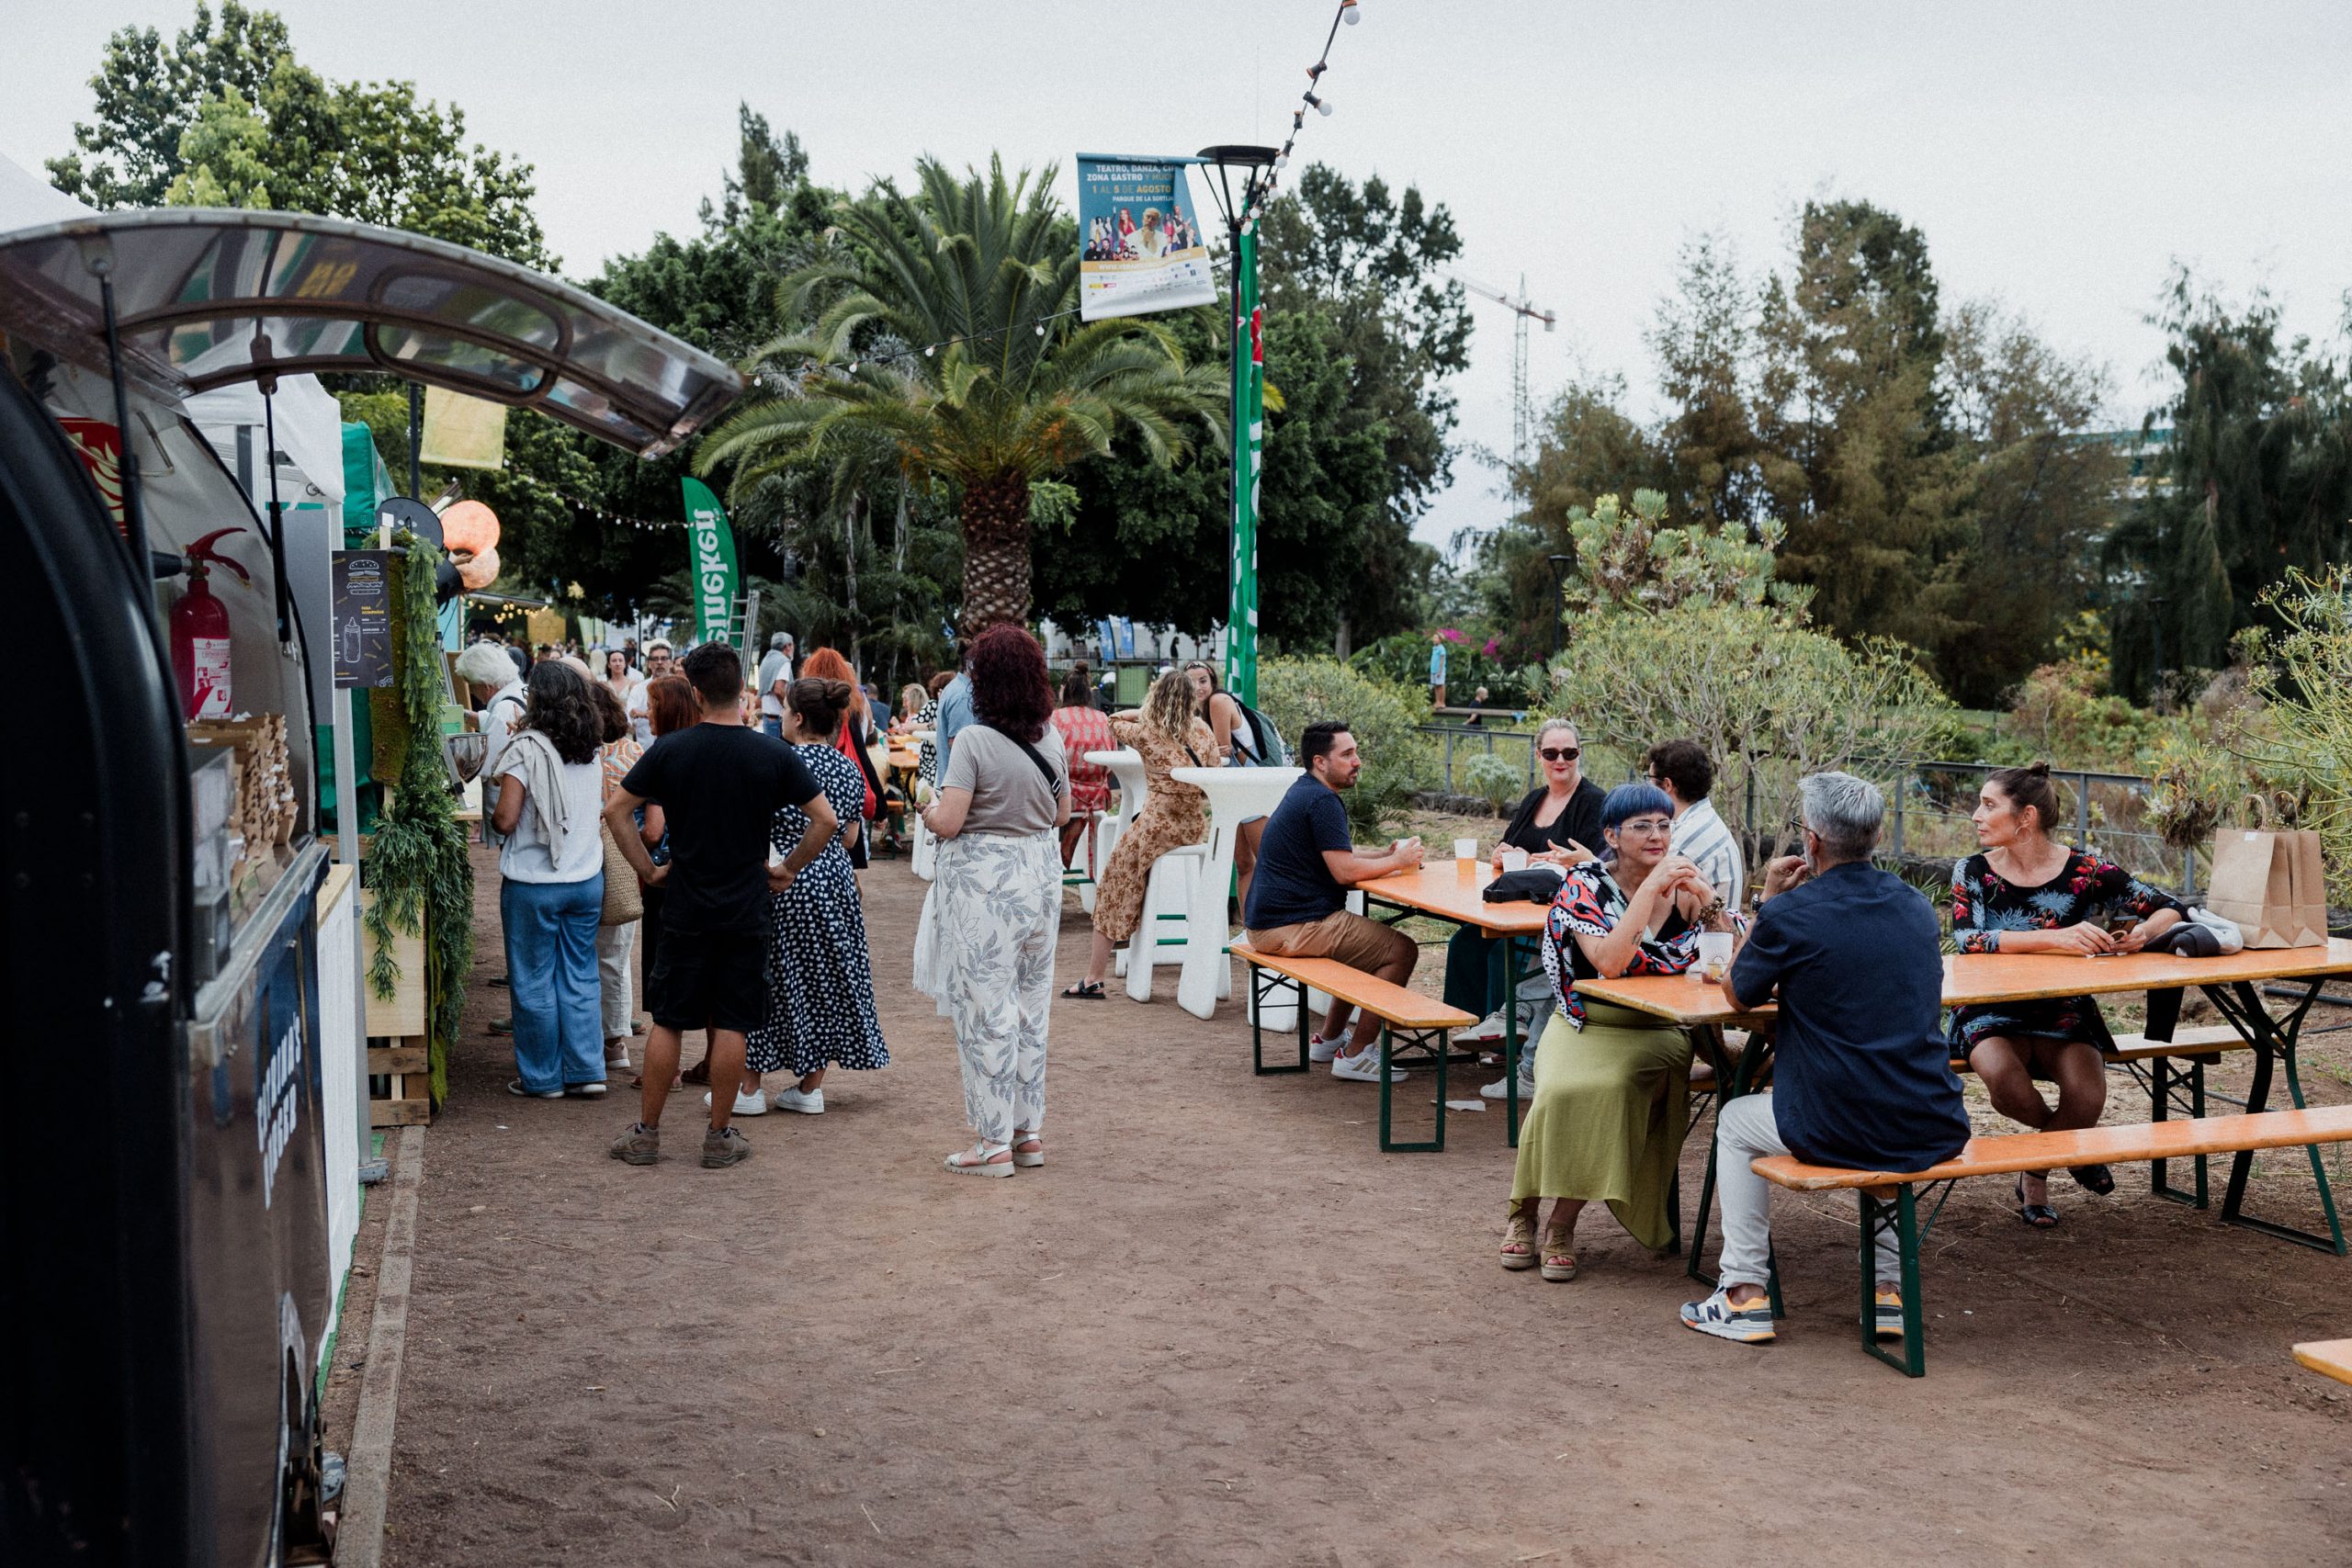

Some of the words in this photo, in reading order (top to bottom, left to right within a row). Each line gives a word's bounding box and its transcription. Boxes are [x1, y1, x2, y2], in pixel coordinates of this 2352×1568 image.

[1096, 164, 1129, 173] TEATRO,
[1131, 164, 1160, 173] DANZA,
[1092, 185, 1097, 194] 1
[1101, 185, 1111, 193] AL
[1123, 185, 1135, 193] DE
[1136, 184, 1171, 193] AGOSTO
[1706, 1303, 1722, 1321] N
